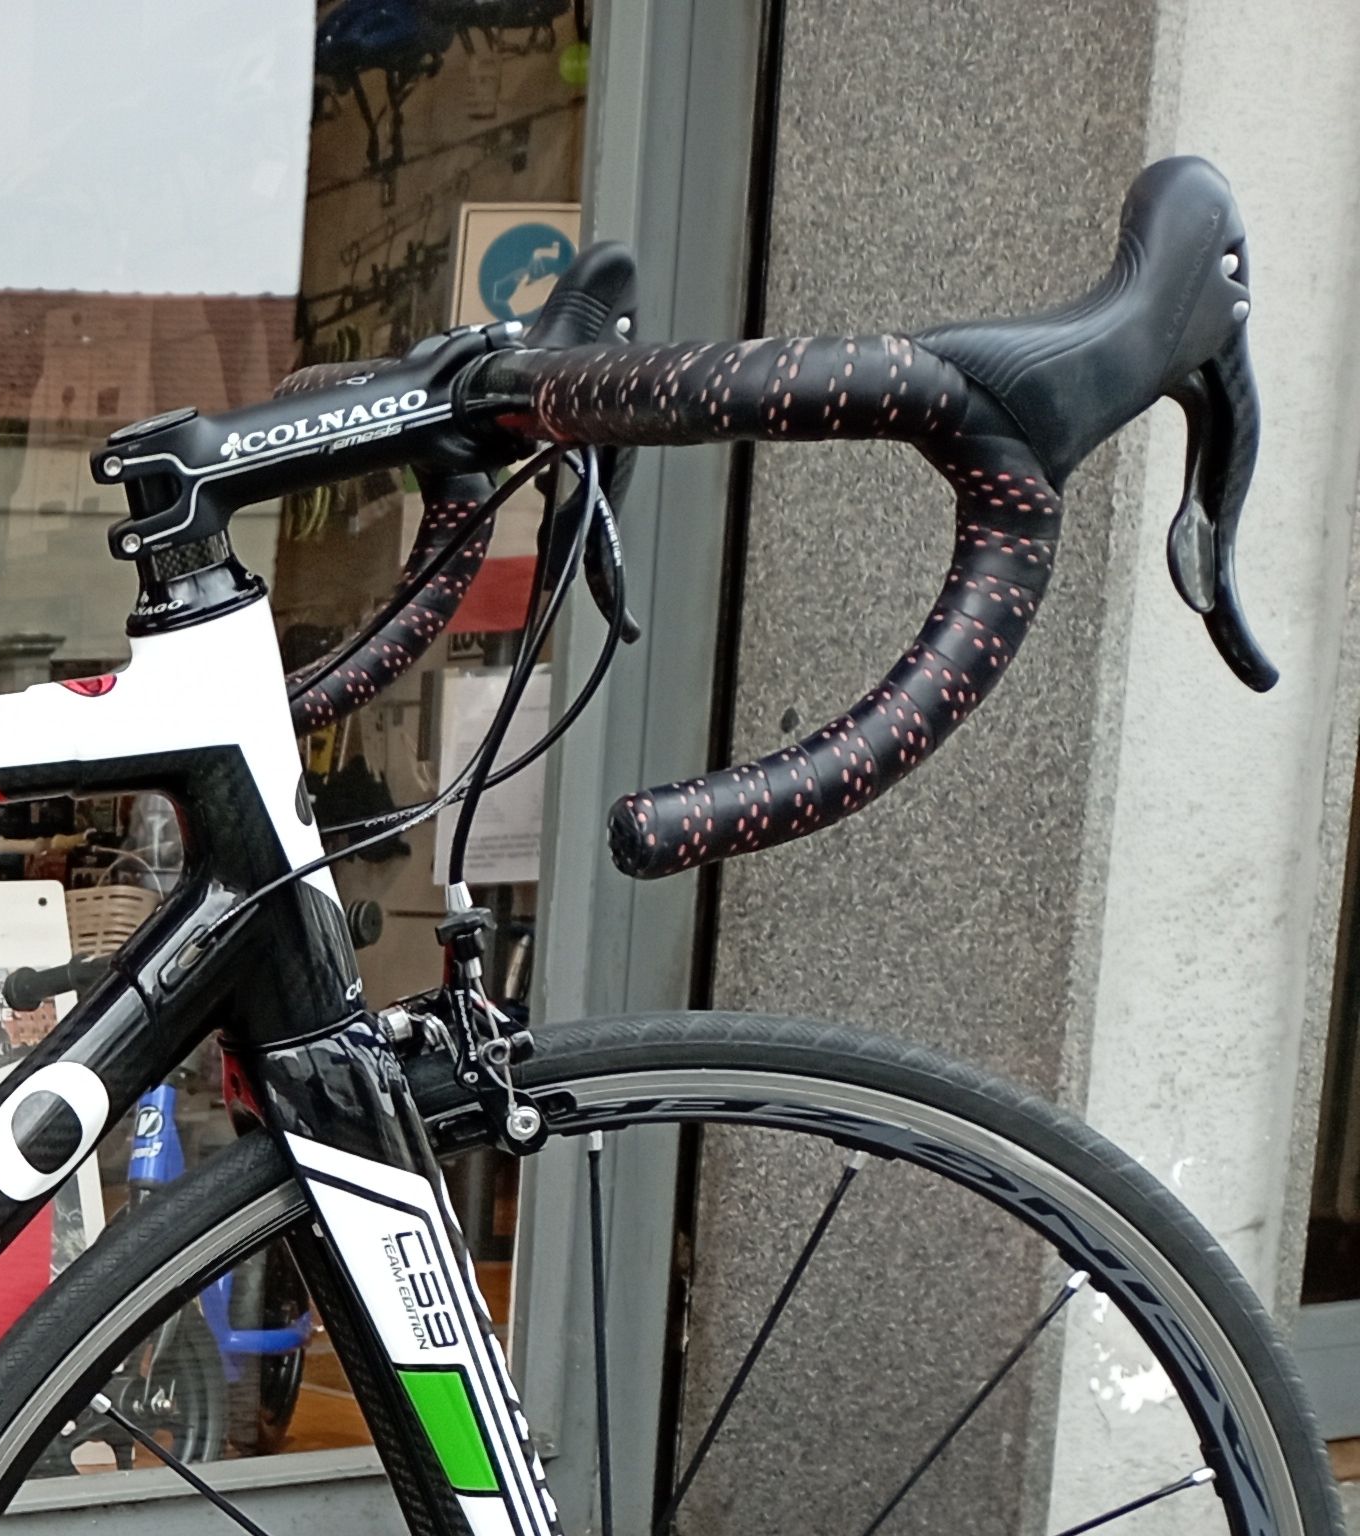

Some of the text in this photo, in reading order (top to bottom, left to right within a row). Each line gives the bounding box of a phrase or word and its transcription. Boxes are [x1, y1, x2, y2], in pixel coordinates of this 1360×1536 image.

[240, 389, 428, 454] COLNAGO
[381, 1233, 430, 1350] TEAM EDITION
